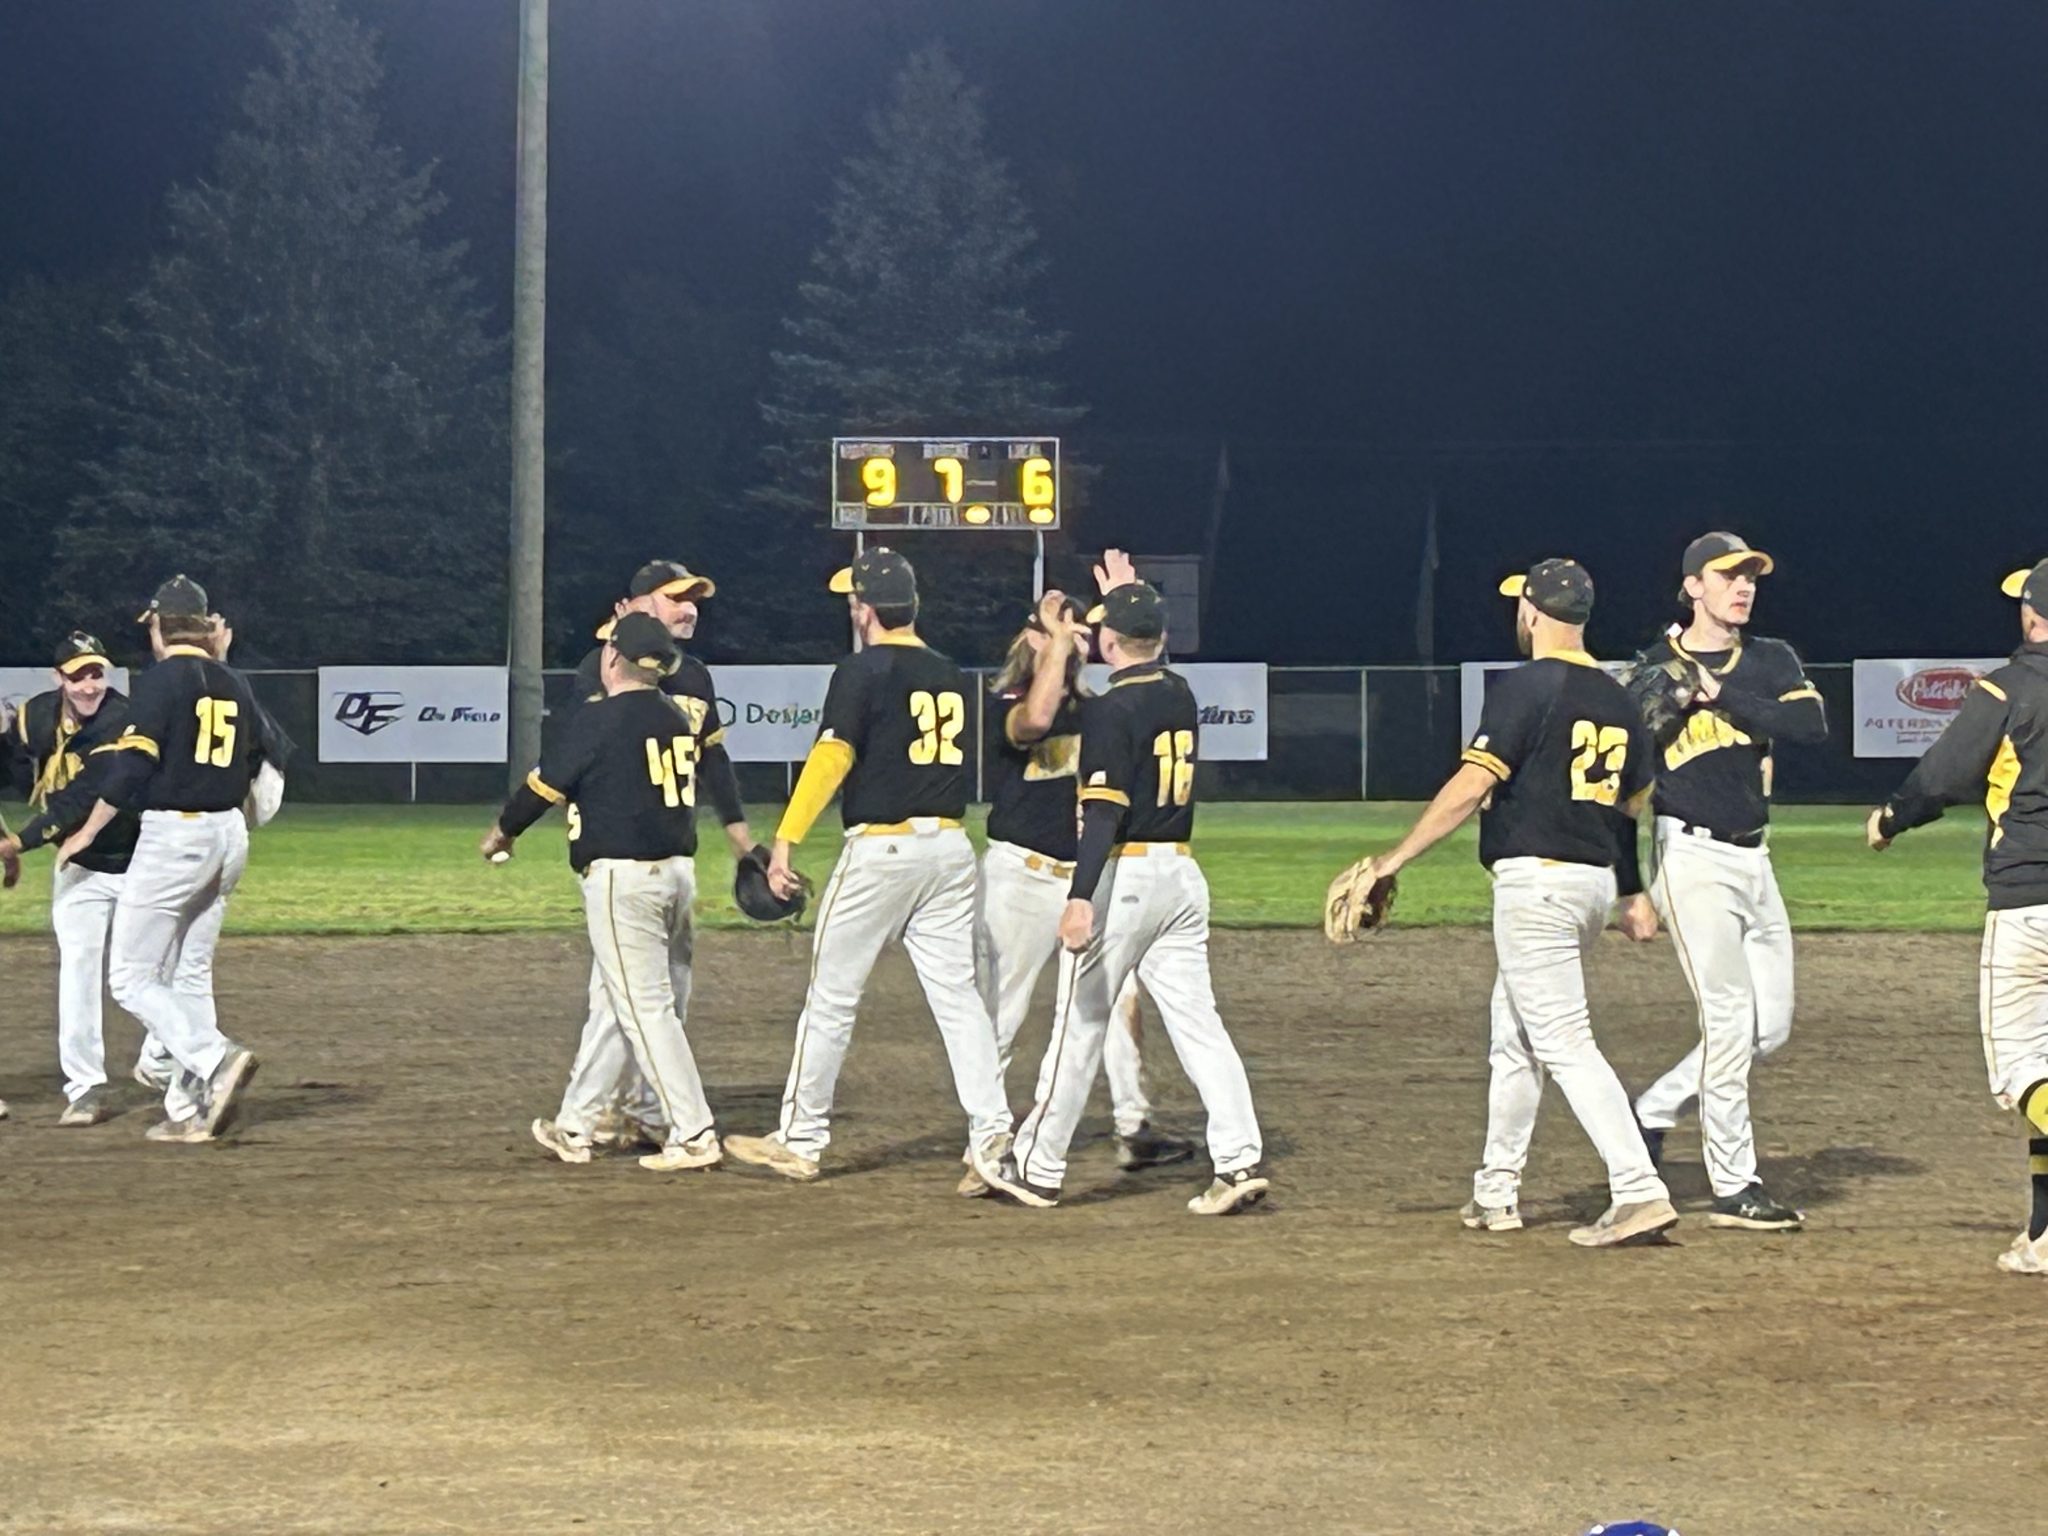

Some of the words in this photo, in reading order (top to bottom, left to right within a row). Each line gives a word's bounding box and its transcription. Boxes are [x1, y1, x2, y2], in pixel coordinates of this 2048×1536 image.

[862, 457, 897, 507] 9
[1022, 457, 1055, 506] 6
[194, 696, 239, 768] 15
[908, 690, 965, 766] 32
[1570, 719, 1629, 806] 23
[645, 735, 697, 808] 45
